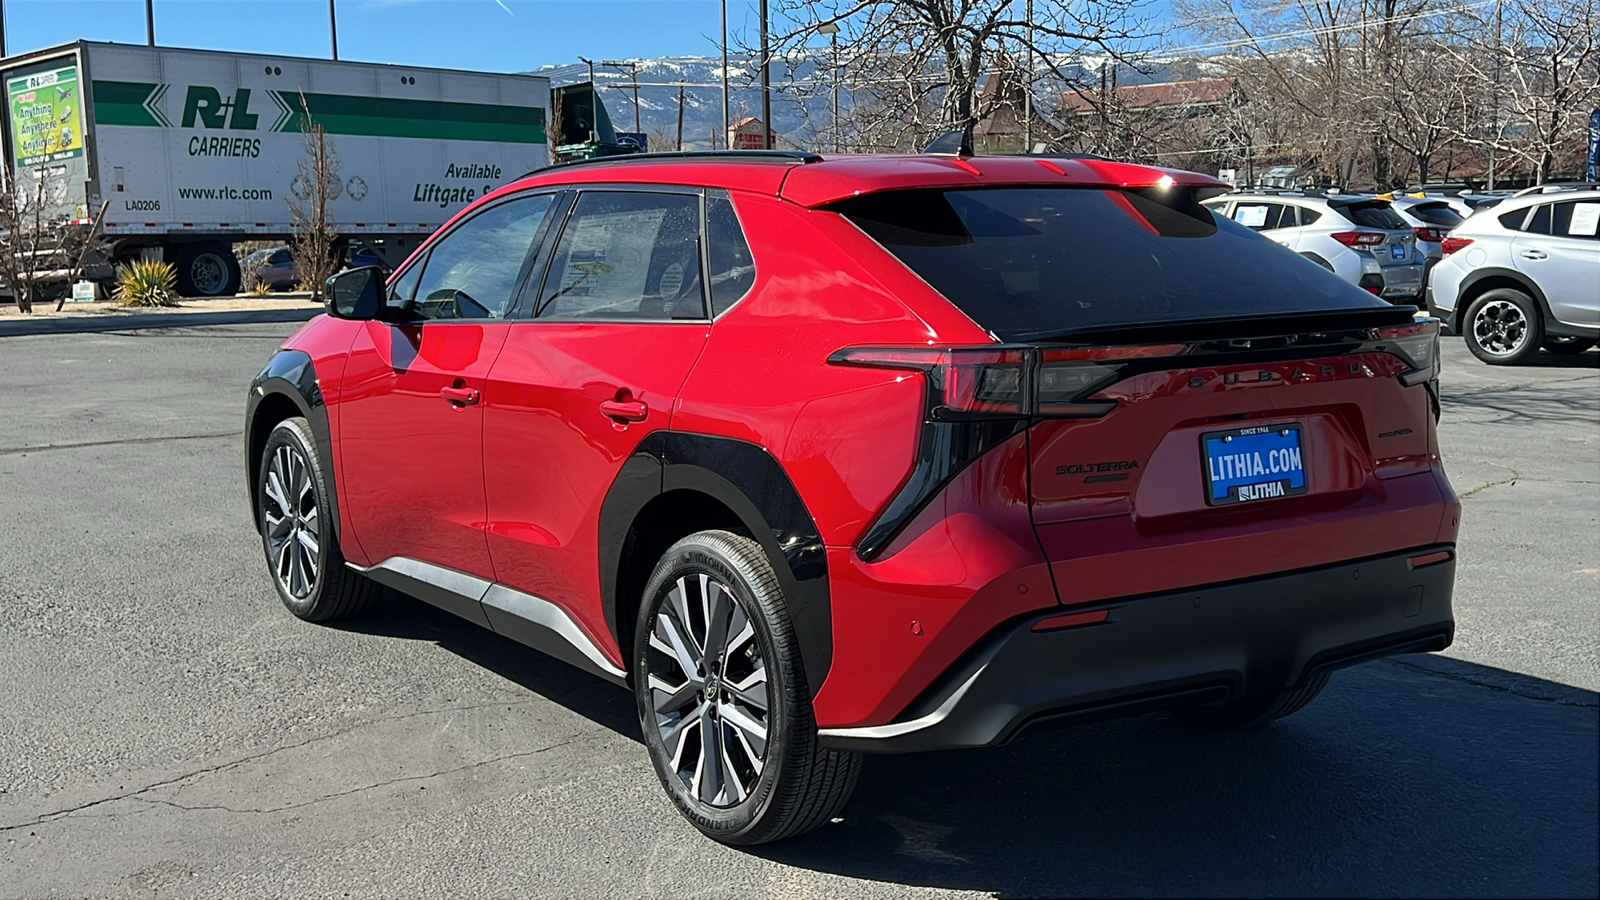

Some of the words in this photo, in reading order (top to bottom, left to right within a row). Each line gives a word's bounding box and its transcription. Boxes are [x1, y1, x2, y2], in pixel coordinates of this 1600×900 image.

[20, 104, 52, 119] Anything
[181, 85, 259, 131] R+L
[21, 120, 58, 135] Anywhere
[188, 136, 261, 158] CARRIERS
[445, 163, 501, 179] Available
[178, 186, 273, 200] www.rlc.com
[413, 183, 475, 208] Liftgate
[125, 200, 161, 211] LA0206
[1188, 361, 1361, 388] SUBARU
[1240, 428, 1256, 436] SINCE
[1257, 426, 1269, 435] 1946
[1056, 460, 1139, 475] SOLTERRA
[1208, 446, 1302, 482] LITHIA.COM
[1249, 481, 1285, 500] LITHIA
[693, 552, 736, 588] YOKOHAMA
